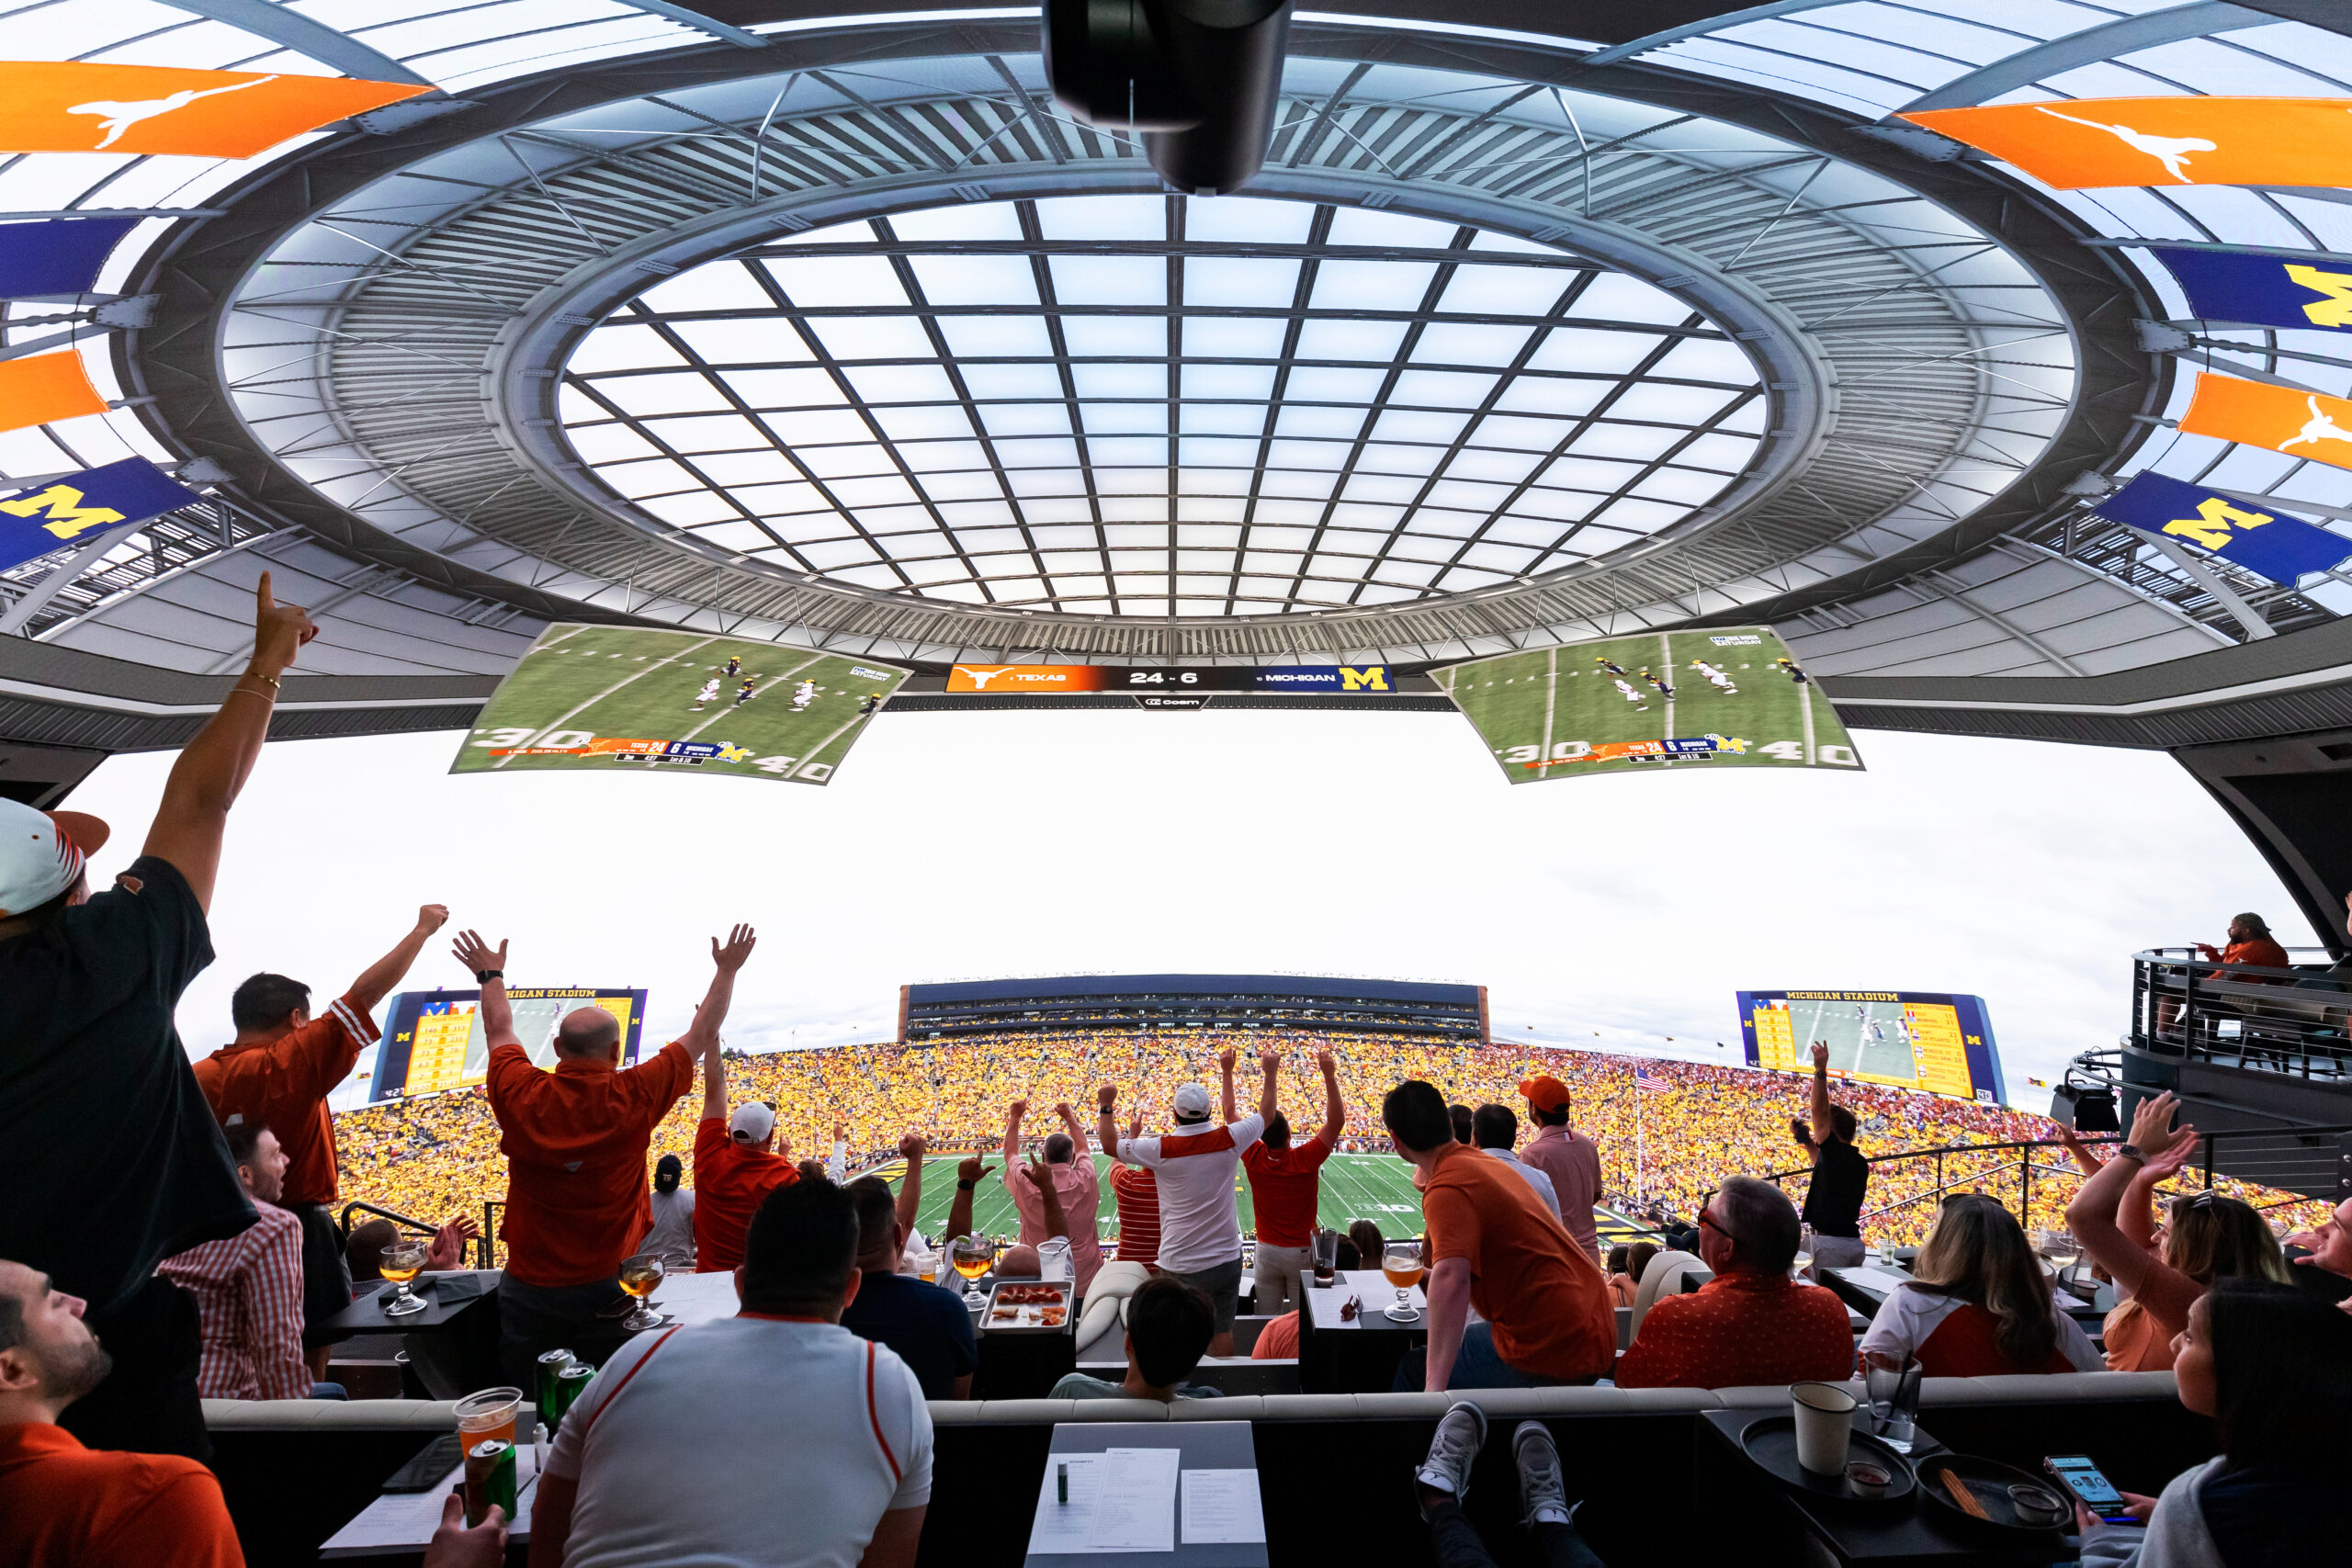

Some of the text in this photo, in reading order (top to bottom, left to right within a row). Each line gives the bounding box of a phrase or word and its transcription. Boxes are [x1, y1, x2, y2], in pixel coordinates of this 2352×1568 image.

[0, 484, 127, 539] M
[2162, 497, 2274, 551] M
[1129, 672, 1164, 683] 24
[1181, 672, 1198, 683] 6
[1339, 667, 1389, 690] M
[648, 742, 667, 752] 24
[670, 743, 715, 753] 6 MICHIGAN
[1645, 742, 1663, 752] 24
[1666, 741, 1678, 751] 6
[507, 989, 595, 998] HIGAN STADIUM
[1786, 991, 1899, 1002] MICHIGAN STADIUM
[1744, 1020, 1753, 1028] M
[396, 1032, 411, 1043] M
[1966, 1034, 1982, 1045] M
